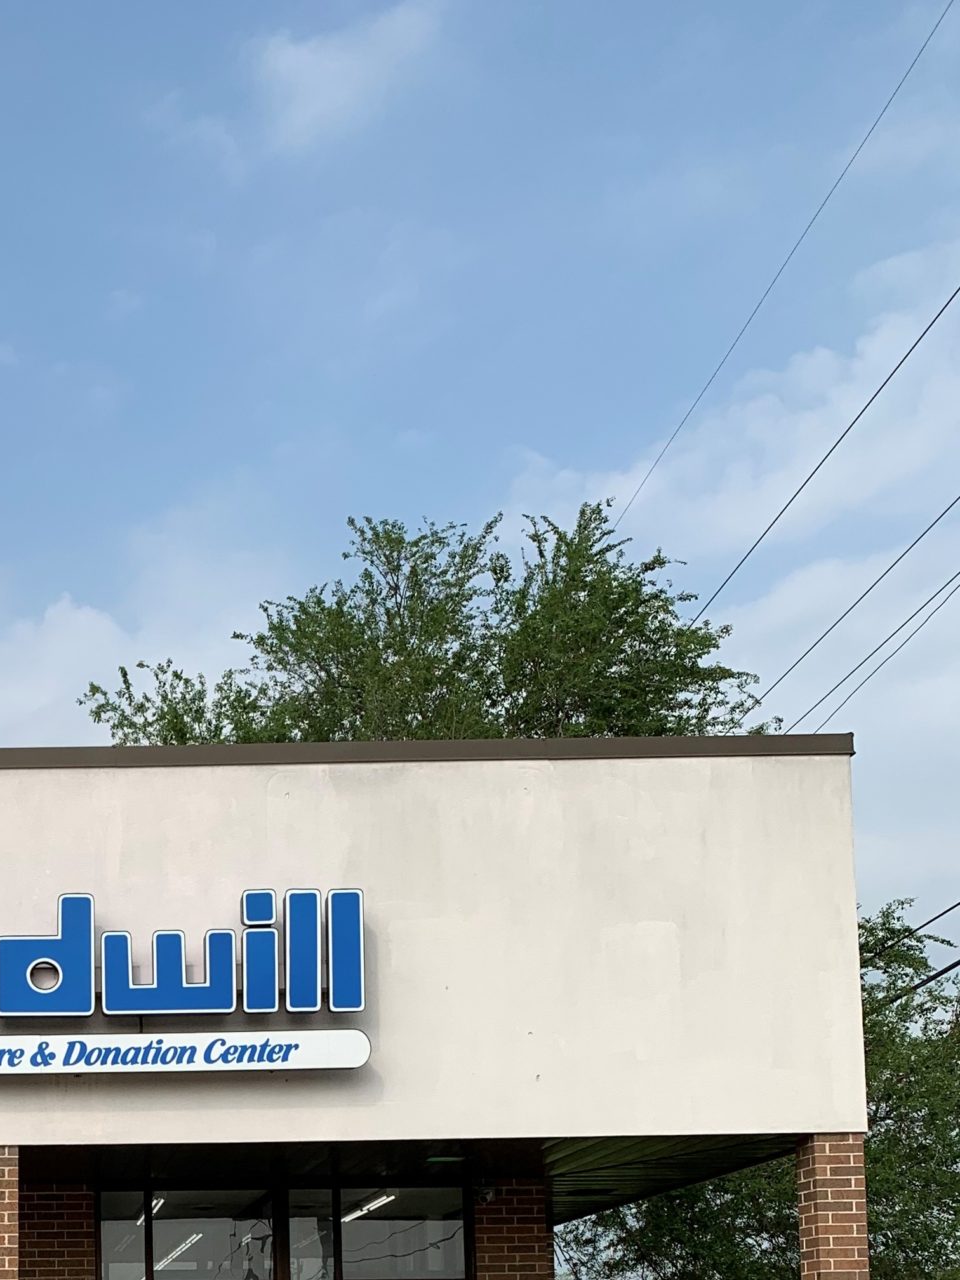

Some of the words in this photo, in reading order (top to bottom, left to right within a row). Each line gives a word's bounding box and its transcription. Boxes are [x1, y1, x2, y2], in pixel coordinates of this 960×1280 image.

[30, 1041, 56, 1067] &
[62, 1039, 197, 1067] Donation
[203, 1038, 300, 1064] Center
